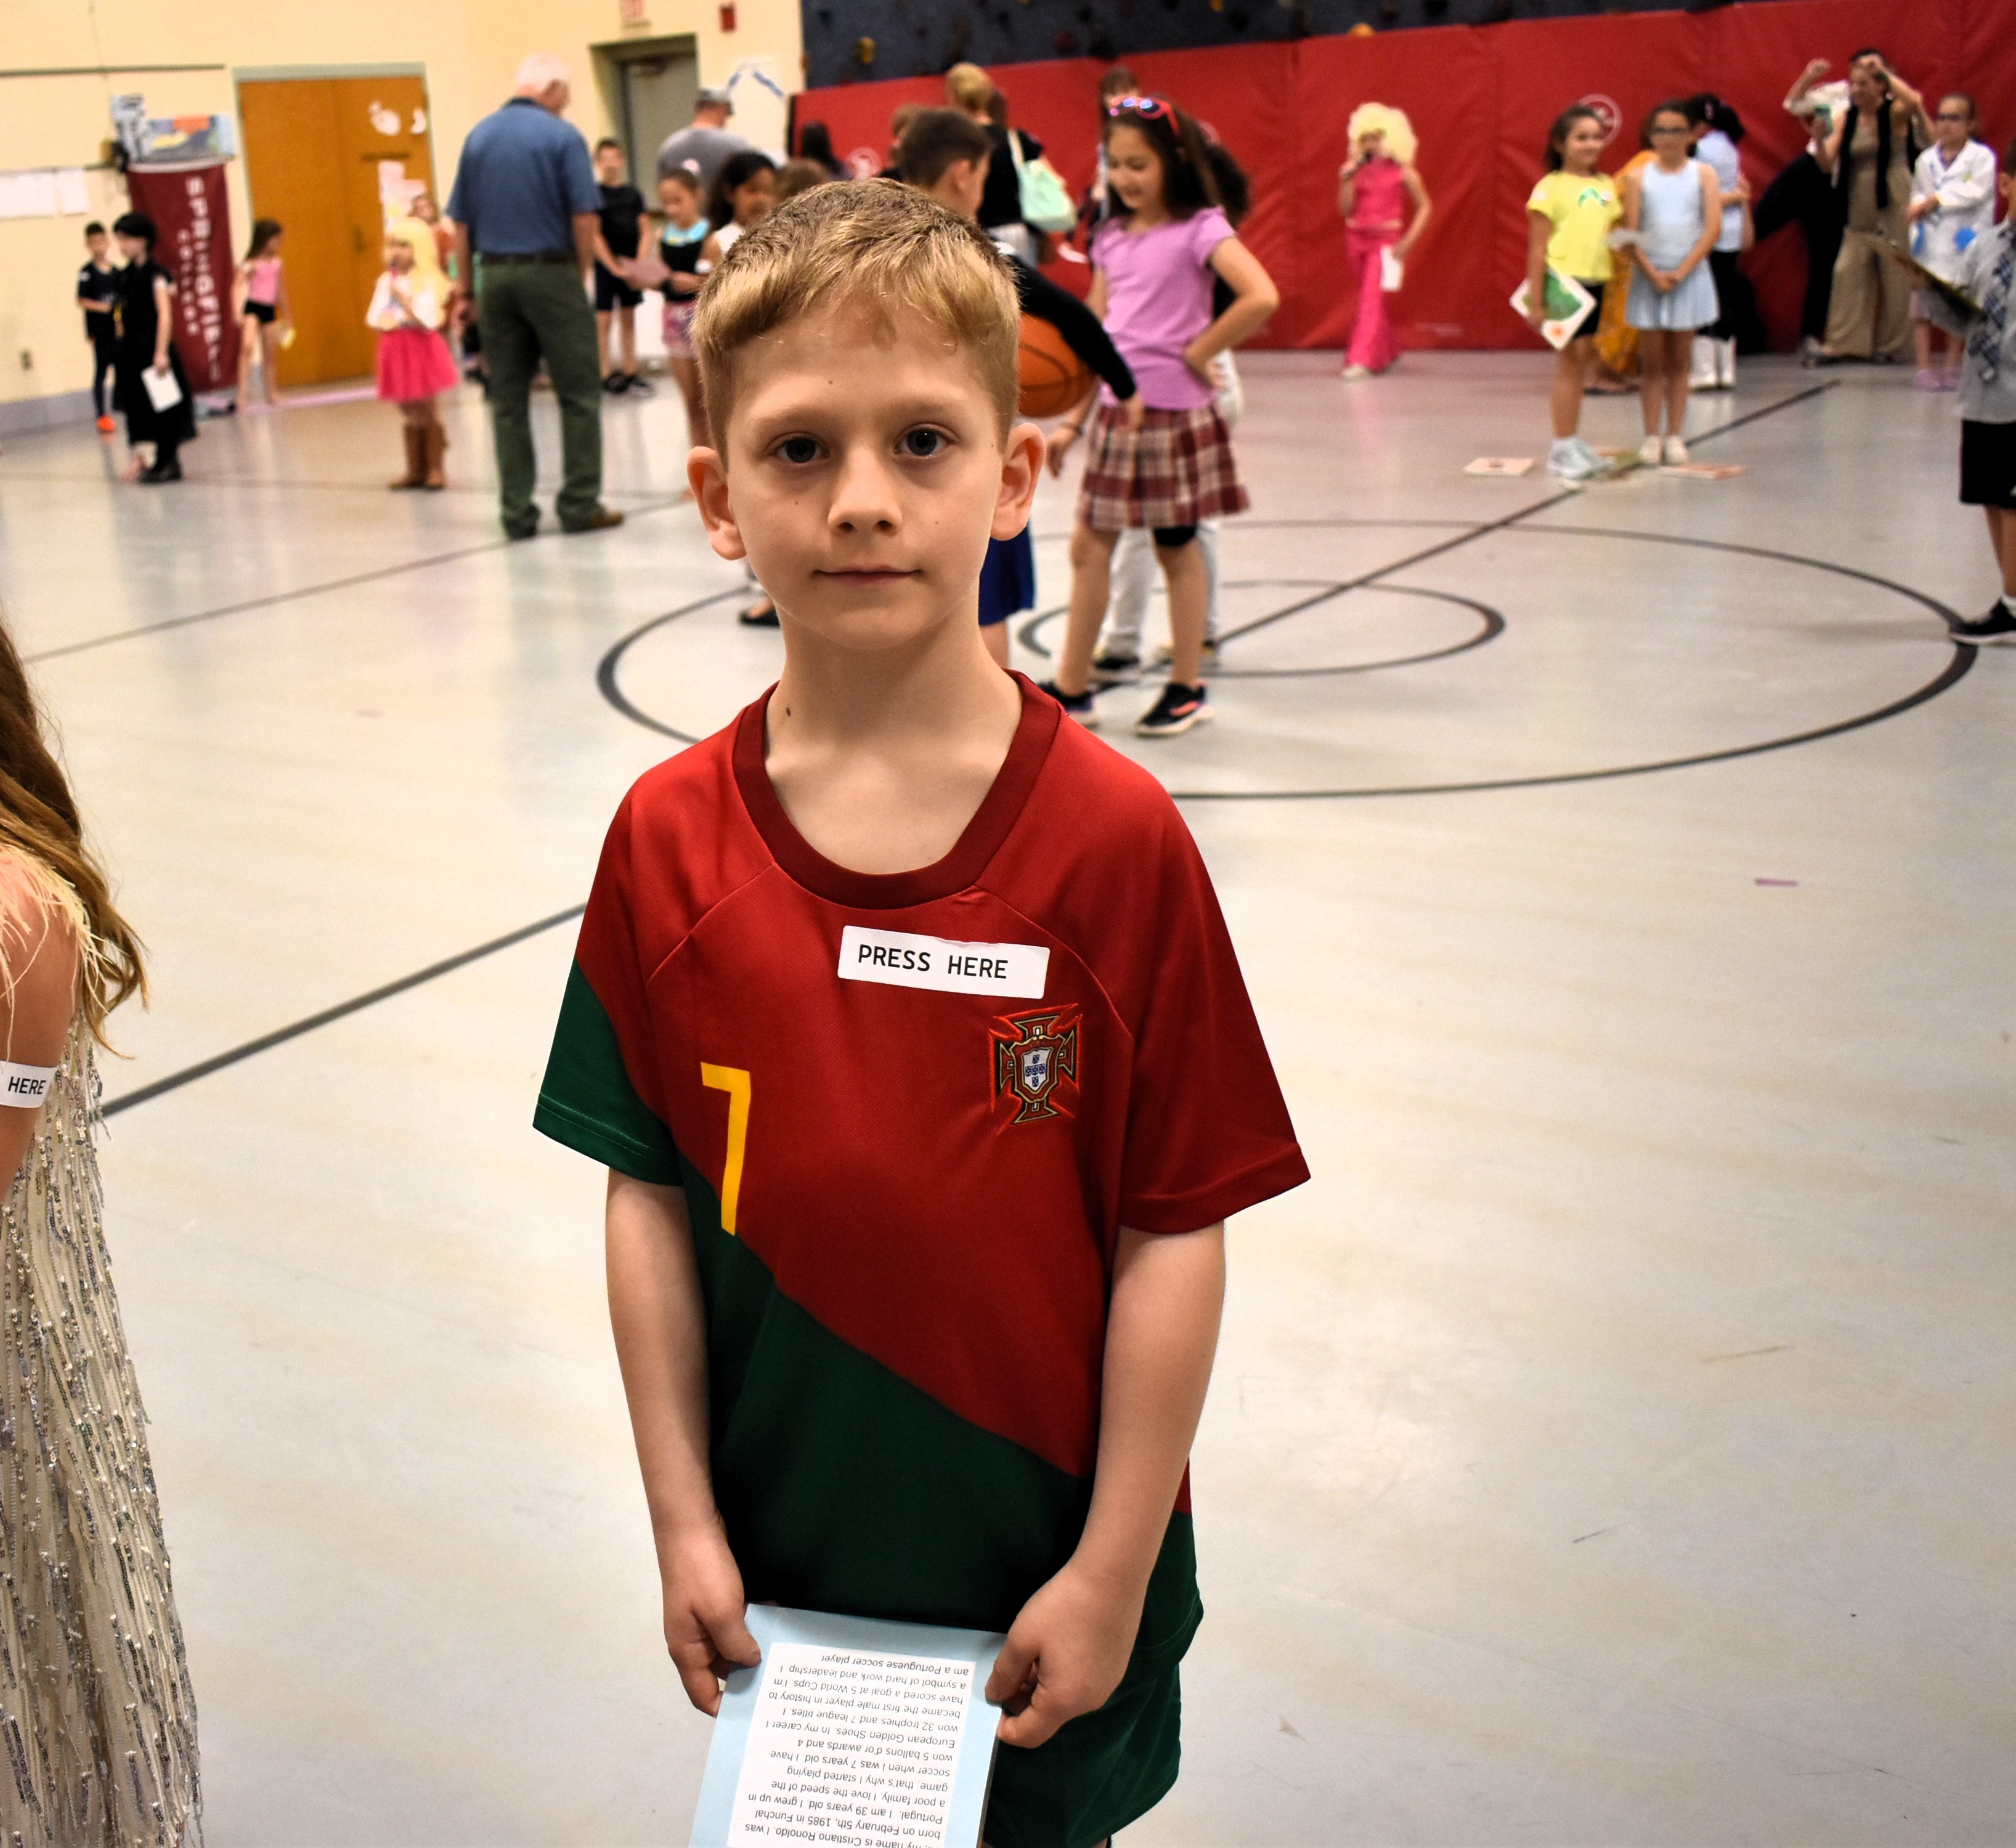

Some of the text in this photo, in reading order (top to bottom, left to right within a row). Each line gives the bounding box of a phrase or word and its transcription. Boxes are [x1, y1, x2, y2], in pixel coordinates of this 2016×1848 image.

[858, 944, 1009, 979] PRESS HERE
[8, 1076, 47, 1095] HERE
[701, 1061, 752, 1236] 7
[819, 1654, 850, 1665] player.
[852, 1658, 884, 1667] soccer
[787, 1664, 837, 1678] leadership.
[886, 1661, 941, 1675] Portuguese
[839, 1671, 858, 1679] and
[861, 1673, 882, 1681] work
[774, 1679, 787, 1687] I'm
[792, 1679, 818, 1690] Cups.
[885, 1676, 907, 1685] hard
[909, 1678, 919, 1686] of
[922, 1679, 957, 1688] symbol
[820, 1683, 847, 1693] World
[851, 1686, 856, 1695] 5
[871, 1687, 892, 1696] goal
[768, 1692, 778, 1700] to
[780, 1691, 811, 1704] history
[903, 1692, 937, 1700] scored
[940, 1695, 963, 1705] have
[825, 1697, 855, 1708] player
[857, 1701, 880, 1709] male
[782, 1708, 786, 1716] I
[790, 1708, 813, 1718] titles.
[883, 1704, 900, 1713] first
[903, 1706, 919, 1715] the
[922, 1708, 961, 1719] became
[816, 1710, 848, 1722] league
[851, 1716, 856, 1724] 7
[860, 1716, 878, 1724] and
[772, 1721, 802, 1730] career
[804, 1722, 819, 1732] my
[881, 1718, 919, 1729] trophies
[922, 1722, 934, 1732] 32
[821, 1727, 830, 1735] In
[835, 1728, 866, 1739] Shoes.
[869, 1732, 904, 1743] Golden
[908, 1735, 955, 1749] European
[798, 1739, 953, 1761] won 5 ballons d'or awards and 4
[770, 1751, 950, 1777] soccer when I was 7 years old. I have
[787, 1765, 821, 1779] playing
[823, 1772, 856, 1782] started
[860, 1776, 863, 1784] I
[865, 1775, 885, 1786] why
[888, 1779, 914, 1789] that's
[771, 1781, 786, 1791] the
[788, 1783, 798, 1792] of
[800, 1785, 830, 1794] speed
[832, 1788, 848, 1798] the
[851, 1790, 871, 1801] love
[874, 1793, 876, 1801] I
[881, 1792, 911, 1805] family.
[914, 1797, 937, 1806] poor
[748, 1793, 943, 1825] Portugal. I am 39 years old. I grew up in
[755, 1809, 793, 1823] Funchal
[796, 1814, 805, 1824] in
[807, 1815, 831, 1827] 1985
[745, 1823, 764, 1833] was
[766, 1826, 770, 1835] I
[855, 1820, 900, 1836] February
[903, 1827, 915, 1836] on
[774, 1827, 816, 1841] Ronoldo.
[918, 1829, 941, 1841] born
[818, 1833, 861, 1847] Cristiano
[864, 1838, 872, 1848] is
[876, 1840, 903, 1848] name
